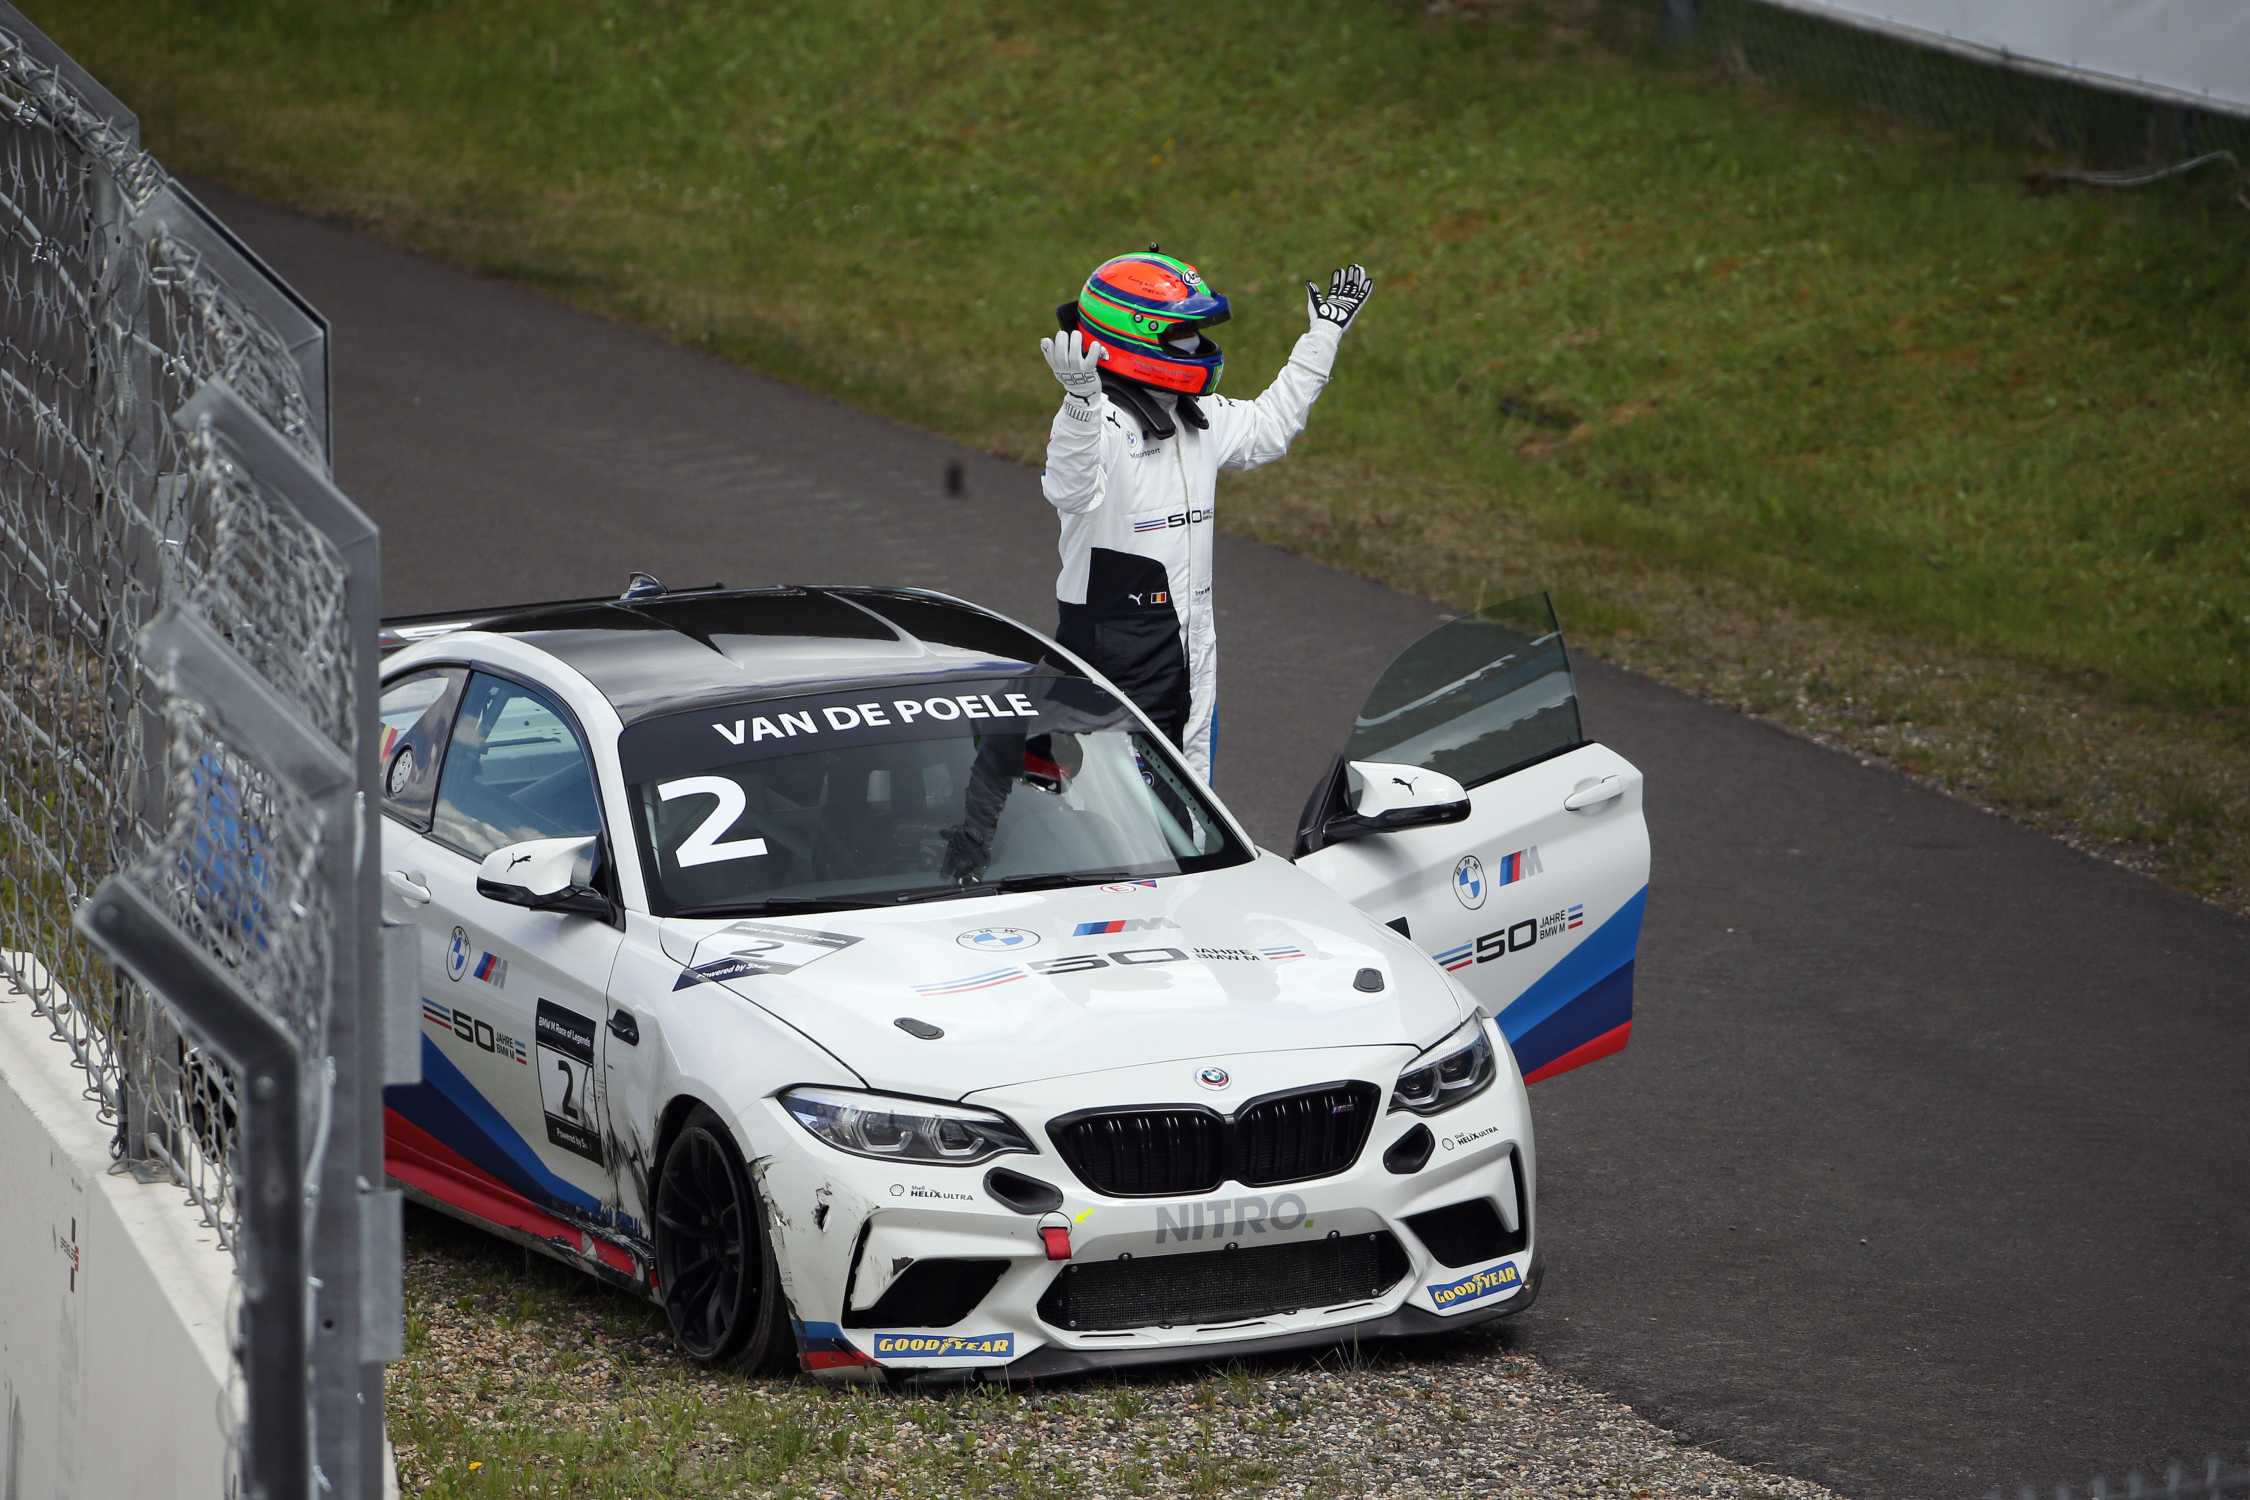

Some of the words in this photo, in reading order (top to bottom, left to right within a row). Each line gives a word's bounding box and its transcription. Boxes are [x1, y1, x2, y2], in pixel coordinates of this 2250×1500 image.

[1167, 509, 1203, 528] 50
[712, 710, 819, 746] VAN
[822, 702, 891, 731] DE
[893, 693, 1041, 723] POELE
[657, 775, 769, 868] 2
[1539, 910, 1566, 929] JAHRE
[1475, 918, 1538, 964] 50
[1539, 925, 1558, 941] BMW
[1558, 922, 1566, 933] M
[730, 940, 785, 958] 2
[1192, 947, 1254, 956] JAHRE
[1196, 953, 1242, 961] BMW
[734, 964, 746, 976] by
[1026, 947, 1190, 975] 50
[452, 1008, 496, 1053] 50
[495, 1031, 514, 1049] JAHRE
[558, 1060, 579, 1120] 2
[1457, 1132, 1479, 1146] HELIX
[1478, 1126, 1499, 1137] ULTRA
[910, 1189, 943, 1199] HELIX
[943, 1193, 974, 1201] ULTRA
[1434, 1266, 1517, 1304] GOODYEAR
[878, 1338, 1009, 1355] GOODYEAR
